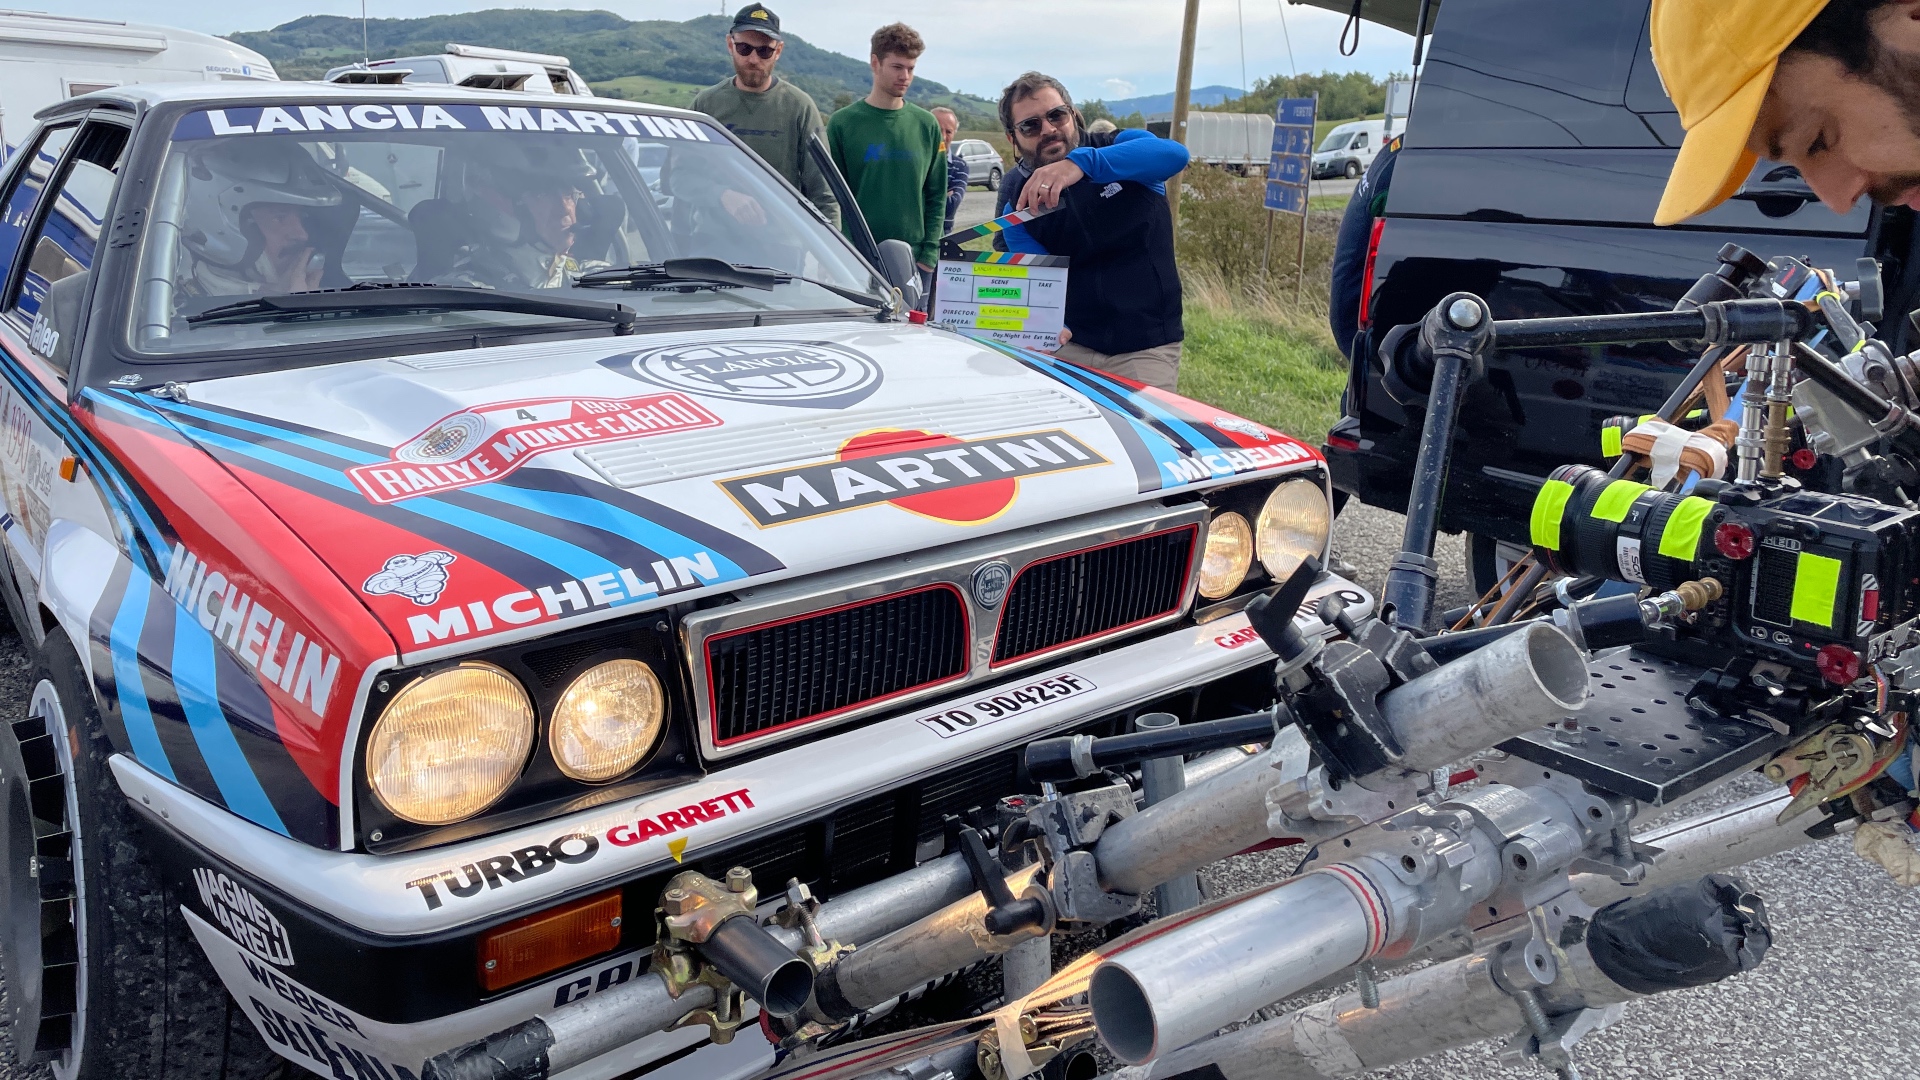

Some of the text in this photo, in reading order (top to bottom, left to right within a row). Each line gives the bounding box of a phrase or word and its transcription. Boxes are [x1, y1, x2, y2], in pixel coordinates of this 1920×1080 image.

[206, 104, 711, 142] LANCIA MARTINI
[942, 308, 977, 317] DIRECTOR:
[1001, 288, 1019, 297] DELTA
[28, 311, 60, 358] Valeo
[695, 350, 816, 375] LANCIA
[515, 408, 538, 422] 4
[574, 400, 633, 415] 1990
[369, 452, 500, 497] RALLYE
[494, 398, 700, 462] MONTE-CARLO
[1162, 441, 1311, 483] MICHELIN
[740, 434, 1093, 518] MARTINI
[406, 551, 720, 645] MICHELIN
[162, 541, 341, 719] MICHELIN
[925, 675, 1084, 733] TO 90425F
[405, 788, 755, 911] TURBO GARRETT
[192, 867, 288, 940] MAGNETI
[238, 950, 369, 1041] WEBER
